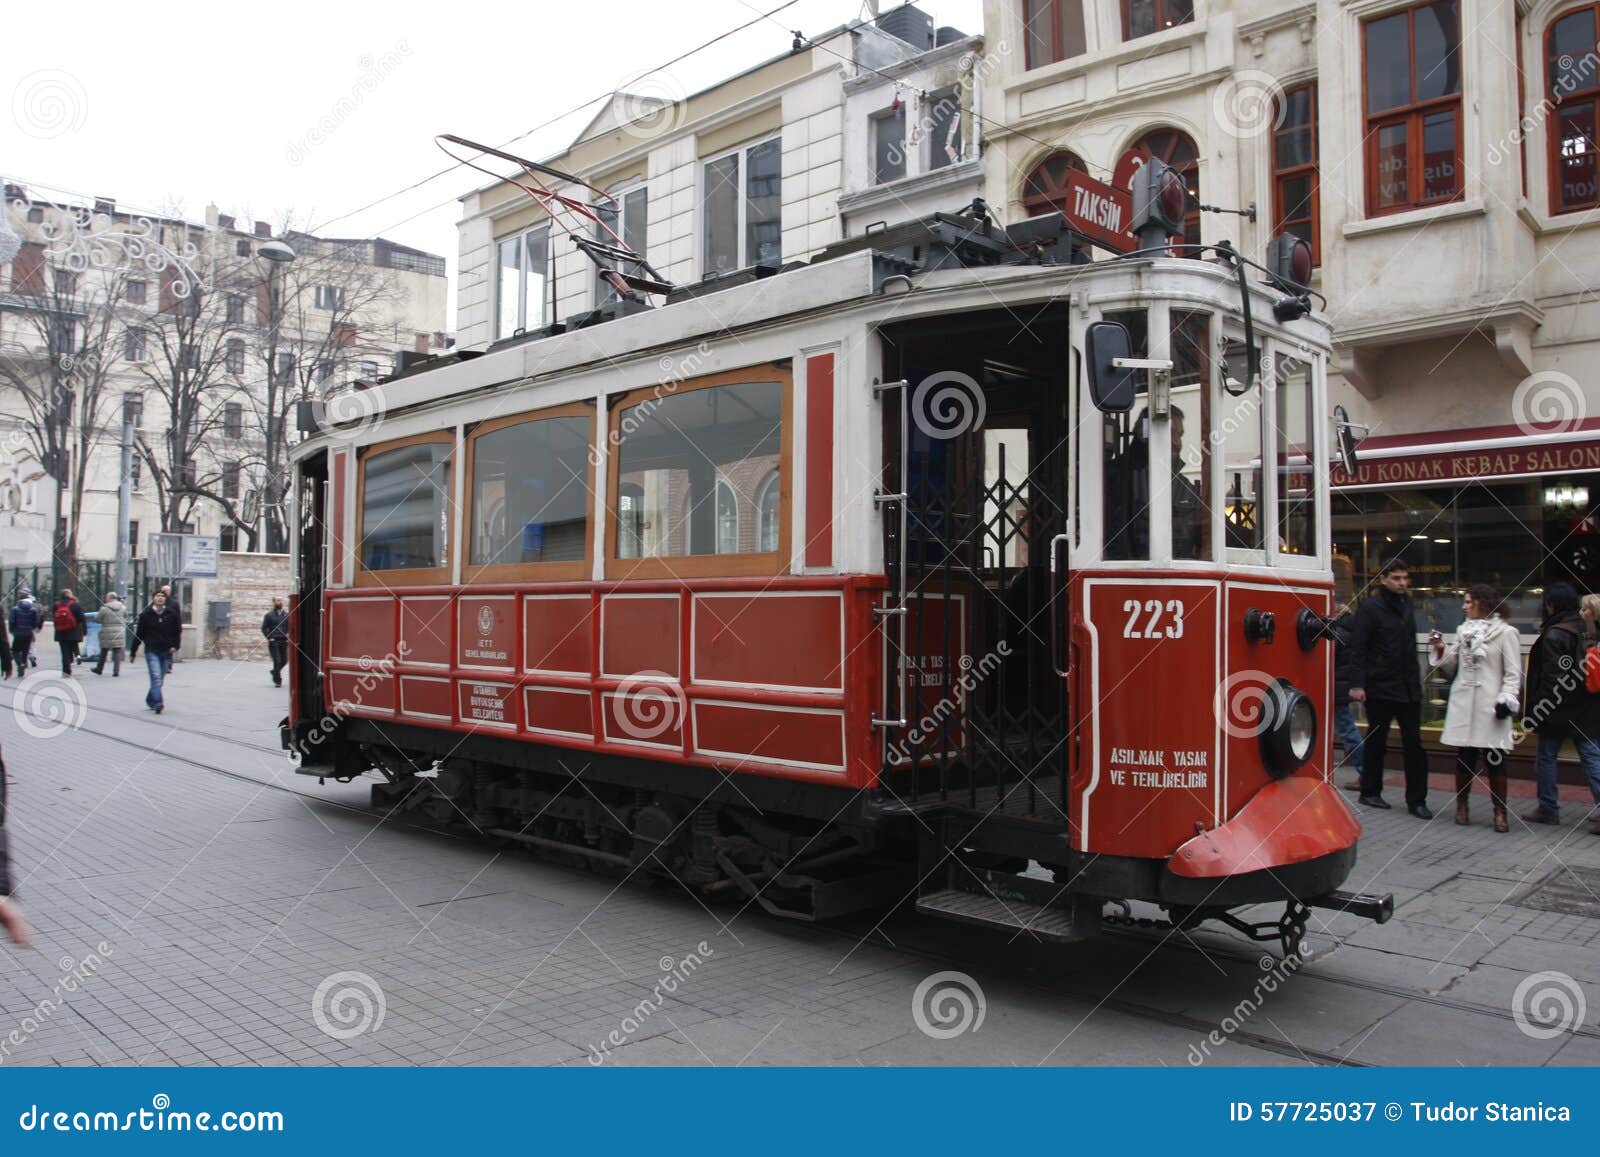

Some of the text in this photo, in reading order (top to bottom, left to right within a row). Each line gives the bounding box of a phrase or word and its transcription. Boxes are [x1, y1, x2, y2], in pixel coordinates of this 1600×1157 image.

[1377, 457, 1445, 481] KONAK
[1452, 453, 1519, 476] KEBAP
[1527, 446, 1600, 471] SALON
[1123, 600, 1185, 640] 223
[1173, 751, 1207, 767] YASAK
[1110, 769, 1127, 786] VE
